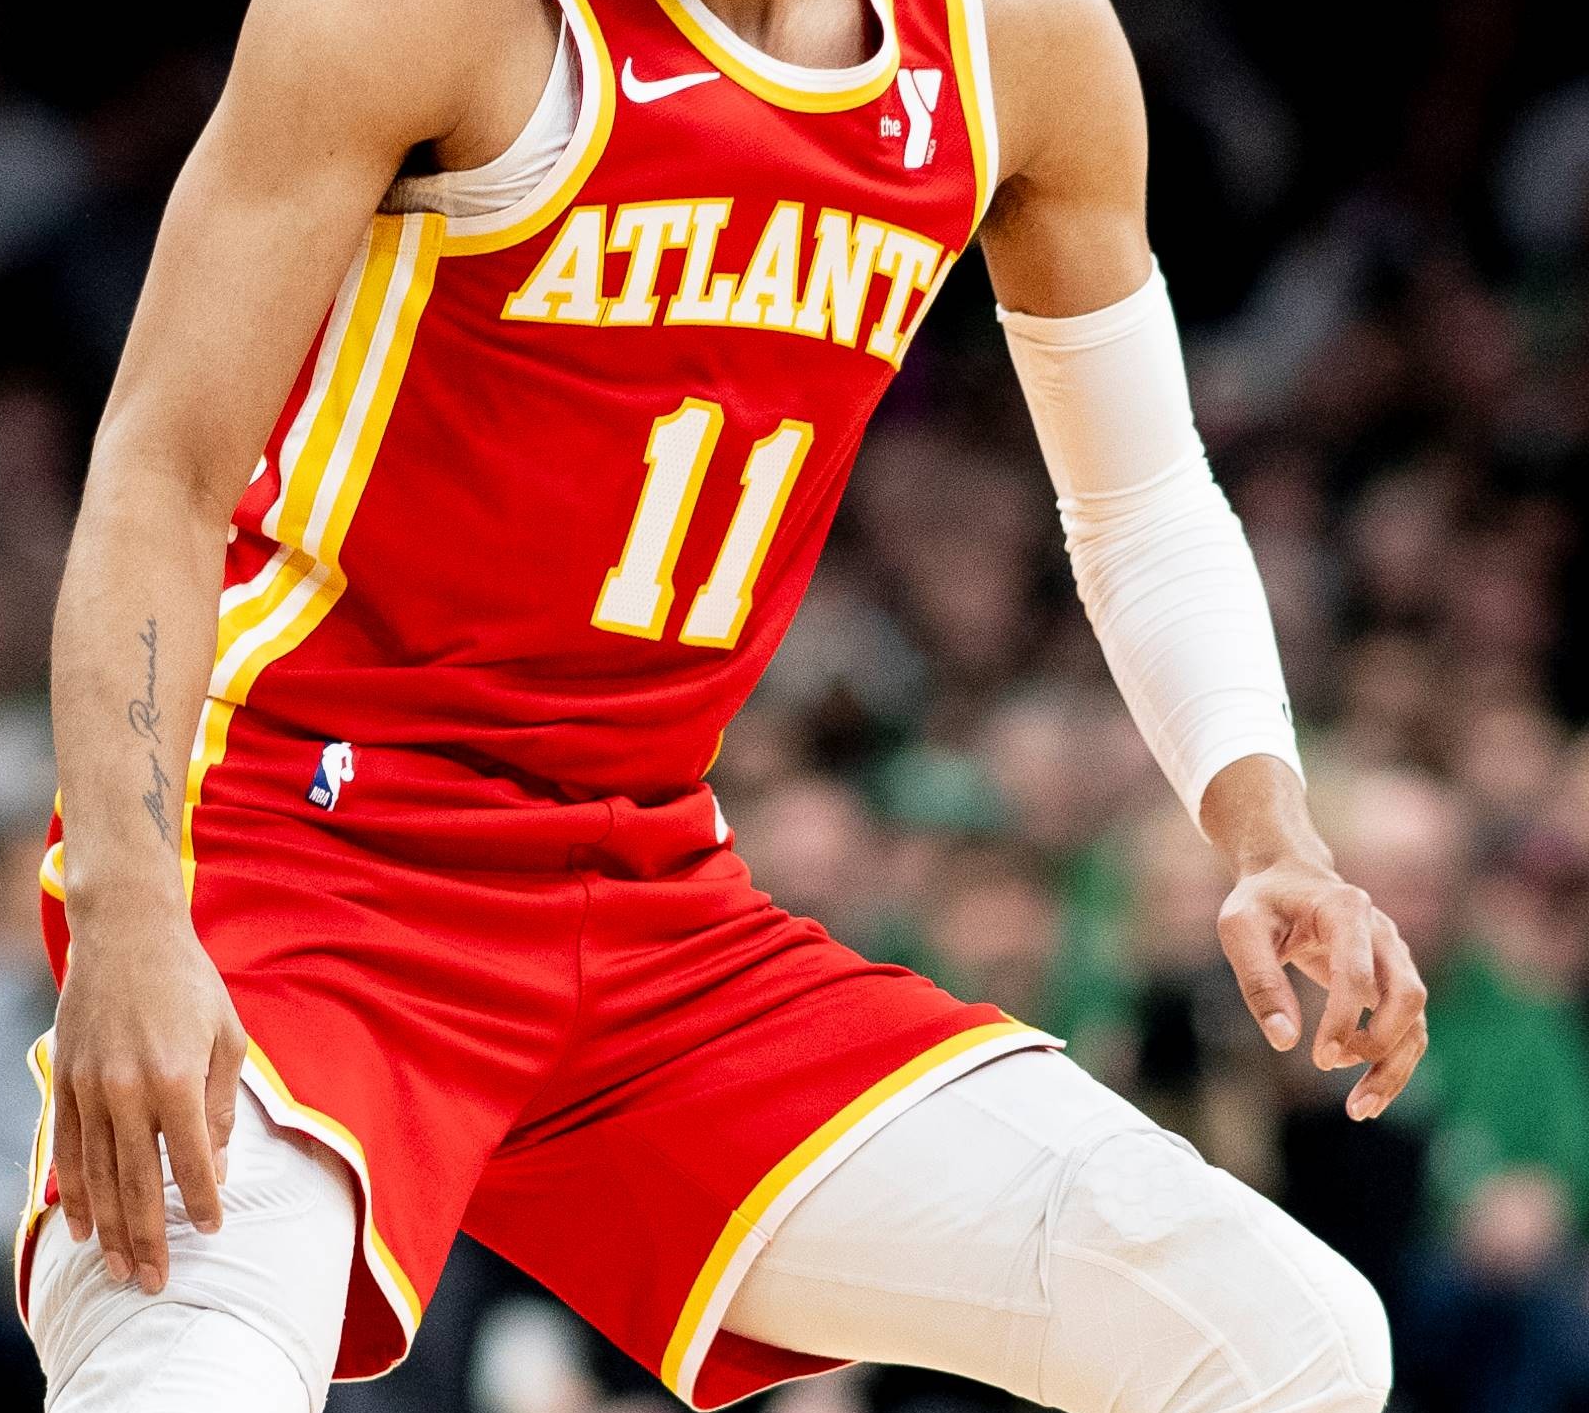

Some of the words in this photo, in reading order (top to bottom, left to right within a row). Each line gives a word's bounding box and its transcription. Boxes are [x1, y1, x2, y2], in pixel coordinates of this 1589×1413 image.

[880, 115, 902, 138] the
[590, 397, 815, 650] 11
[308, 785, 331, 807] NBA
